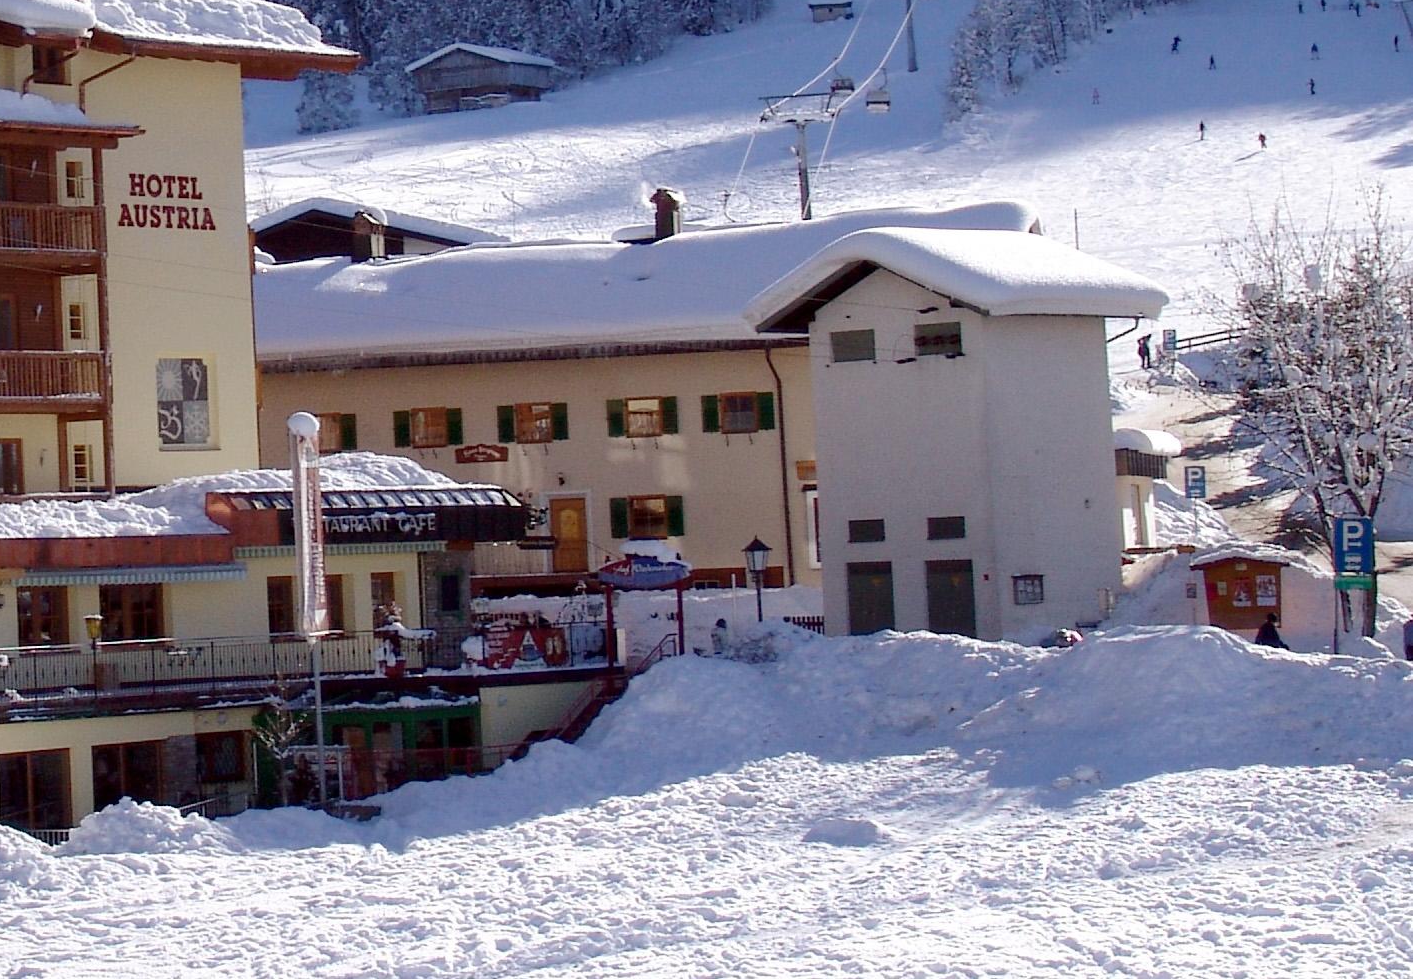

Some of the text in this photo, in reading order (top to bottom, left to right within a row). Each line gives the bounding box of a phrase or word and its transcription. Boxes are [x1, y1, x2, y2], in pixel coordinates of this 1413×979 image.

[128, 173, 203, 200] HOTEL
[118, 204, 216, 231] AUSTRIA
[1188, 468, 1203, 487] P
[324, 515, 387, 533] TAURANT
[1342, 521, 1363, 551] P
